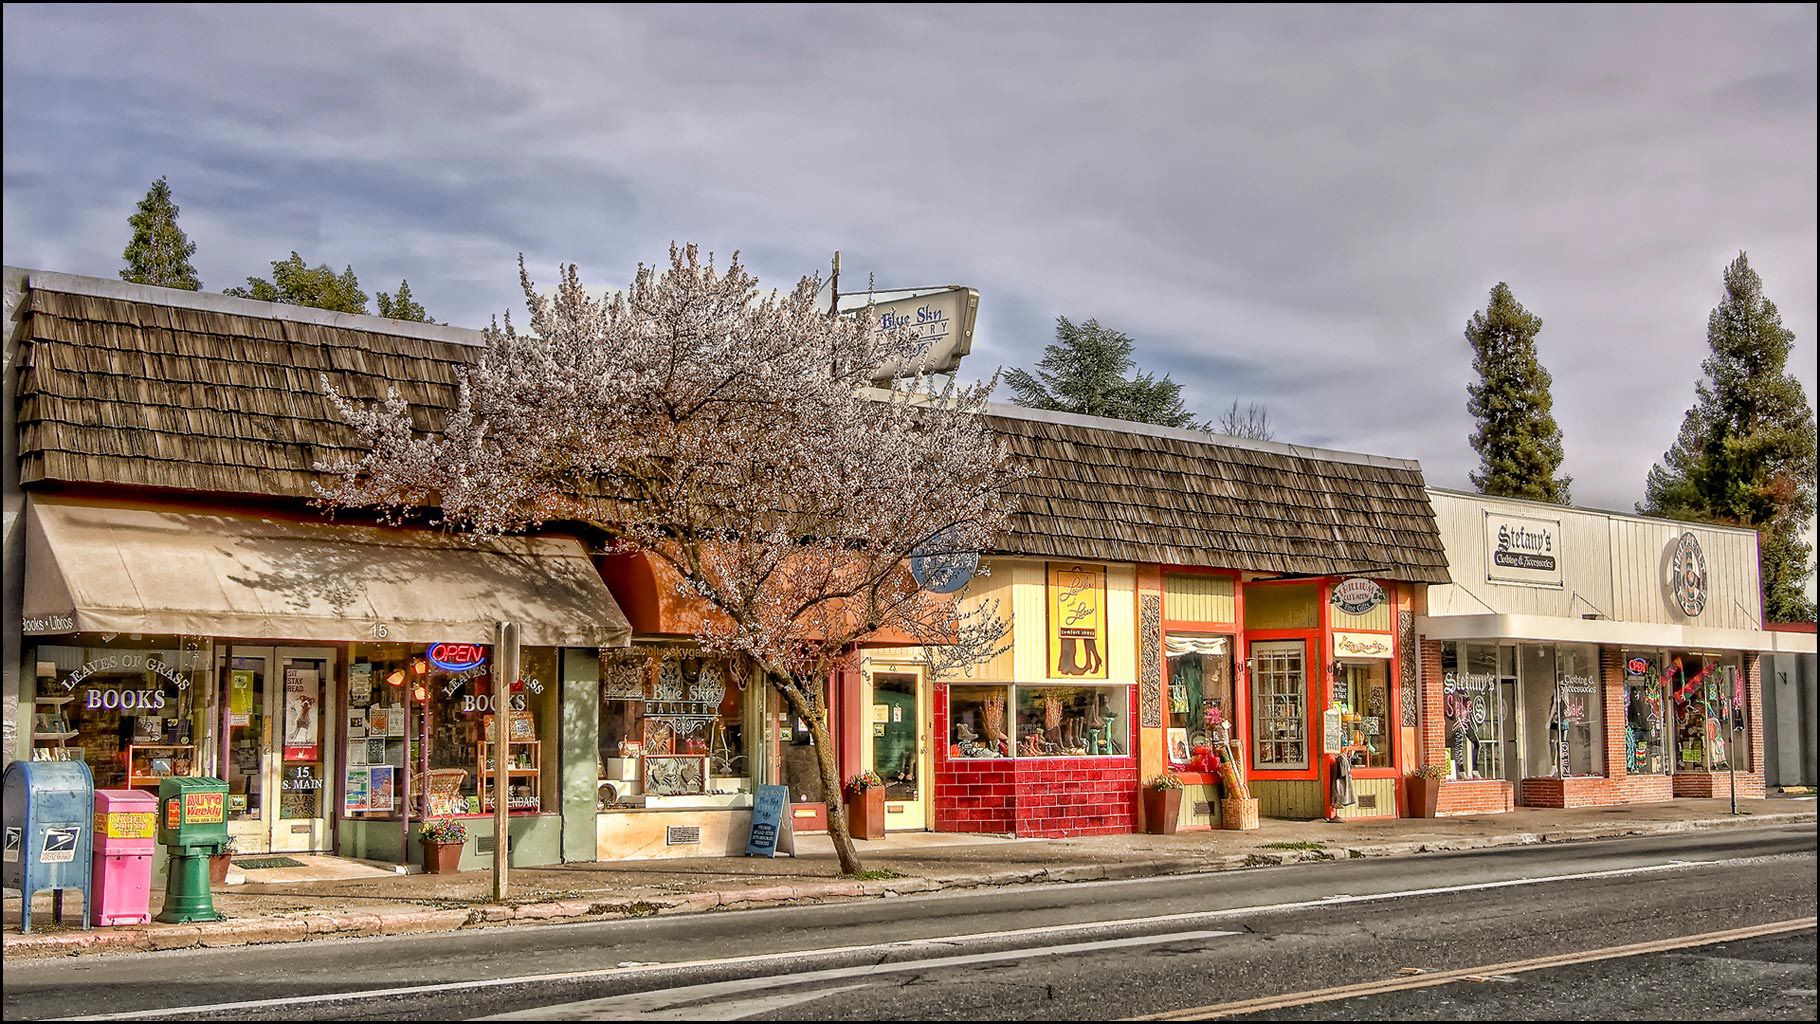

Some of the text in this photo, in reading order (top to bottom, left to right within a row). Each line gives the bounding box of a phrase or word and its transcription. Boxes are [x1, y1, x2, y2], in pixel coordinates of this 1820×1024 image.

[1497, 523, 1552, 554] Stefany's
[1338, 582, 1375, 597] TRILLIUM
[1344, 602, 1371, 612] Fine Gifts
[49, 615, 73, 631] Libros
[371, 623, 388, 638] 15
[432, 644, 483, 662] OPEN
[61, 654, 191, 692] LEAVES OF GRASS
[442, 664, 487, 697] LEAVES
[1564, 674, 1588, 687] Clothing
[287, 677, 304, 685] STAY
[1444, 671, 1495, 695] Stefany's
[87, 689, 165, 709] BOOKS
[646, 703, 719, 714] GALLERY
[296, 766, 310, 778] 15
[282, 779, 323, 790] S. MAIN
[187, 794, 222, 806] AUTO
[187, 805, 222, 817] Weekly
